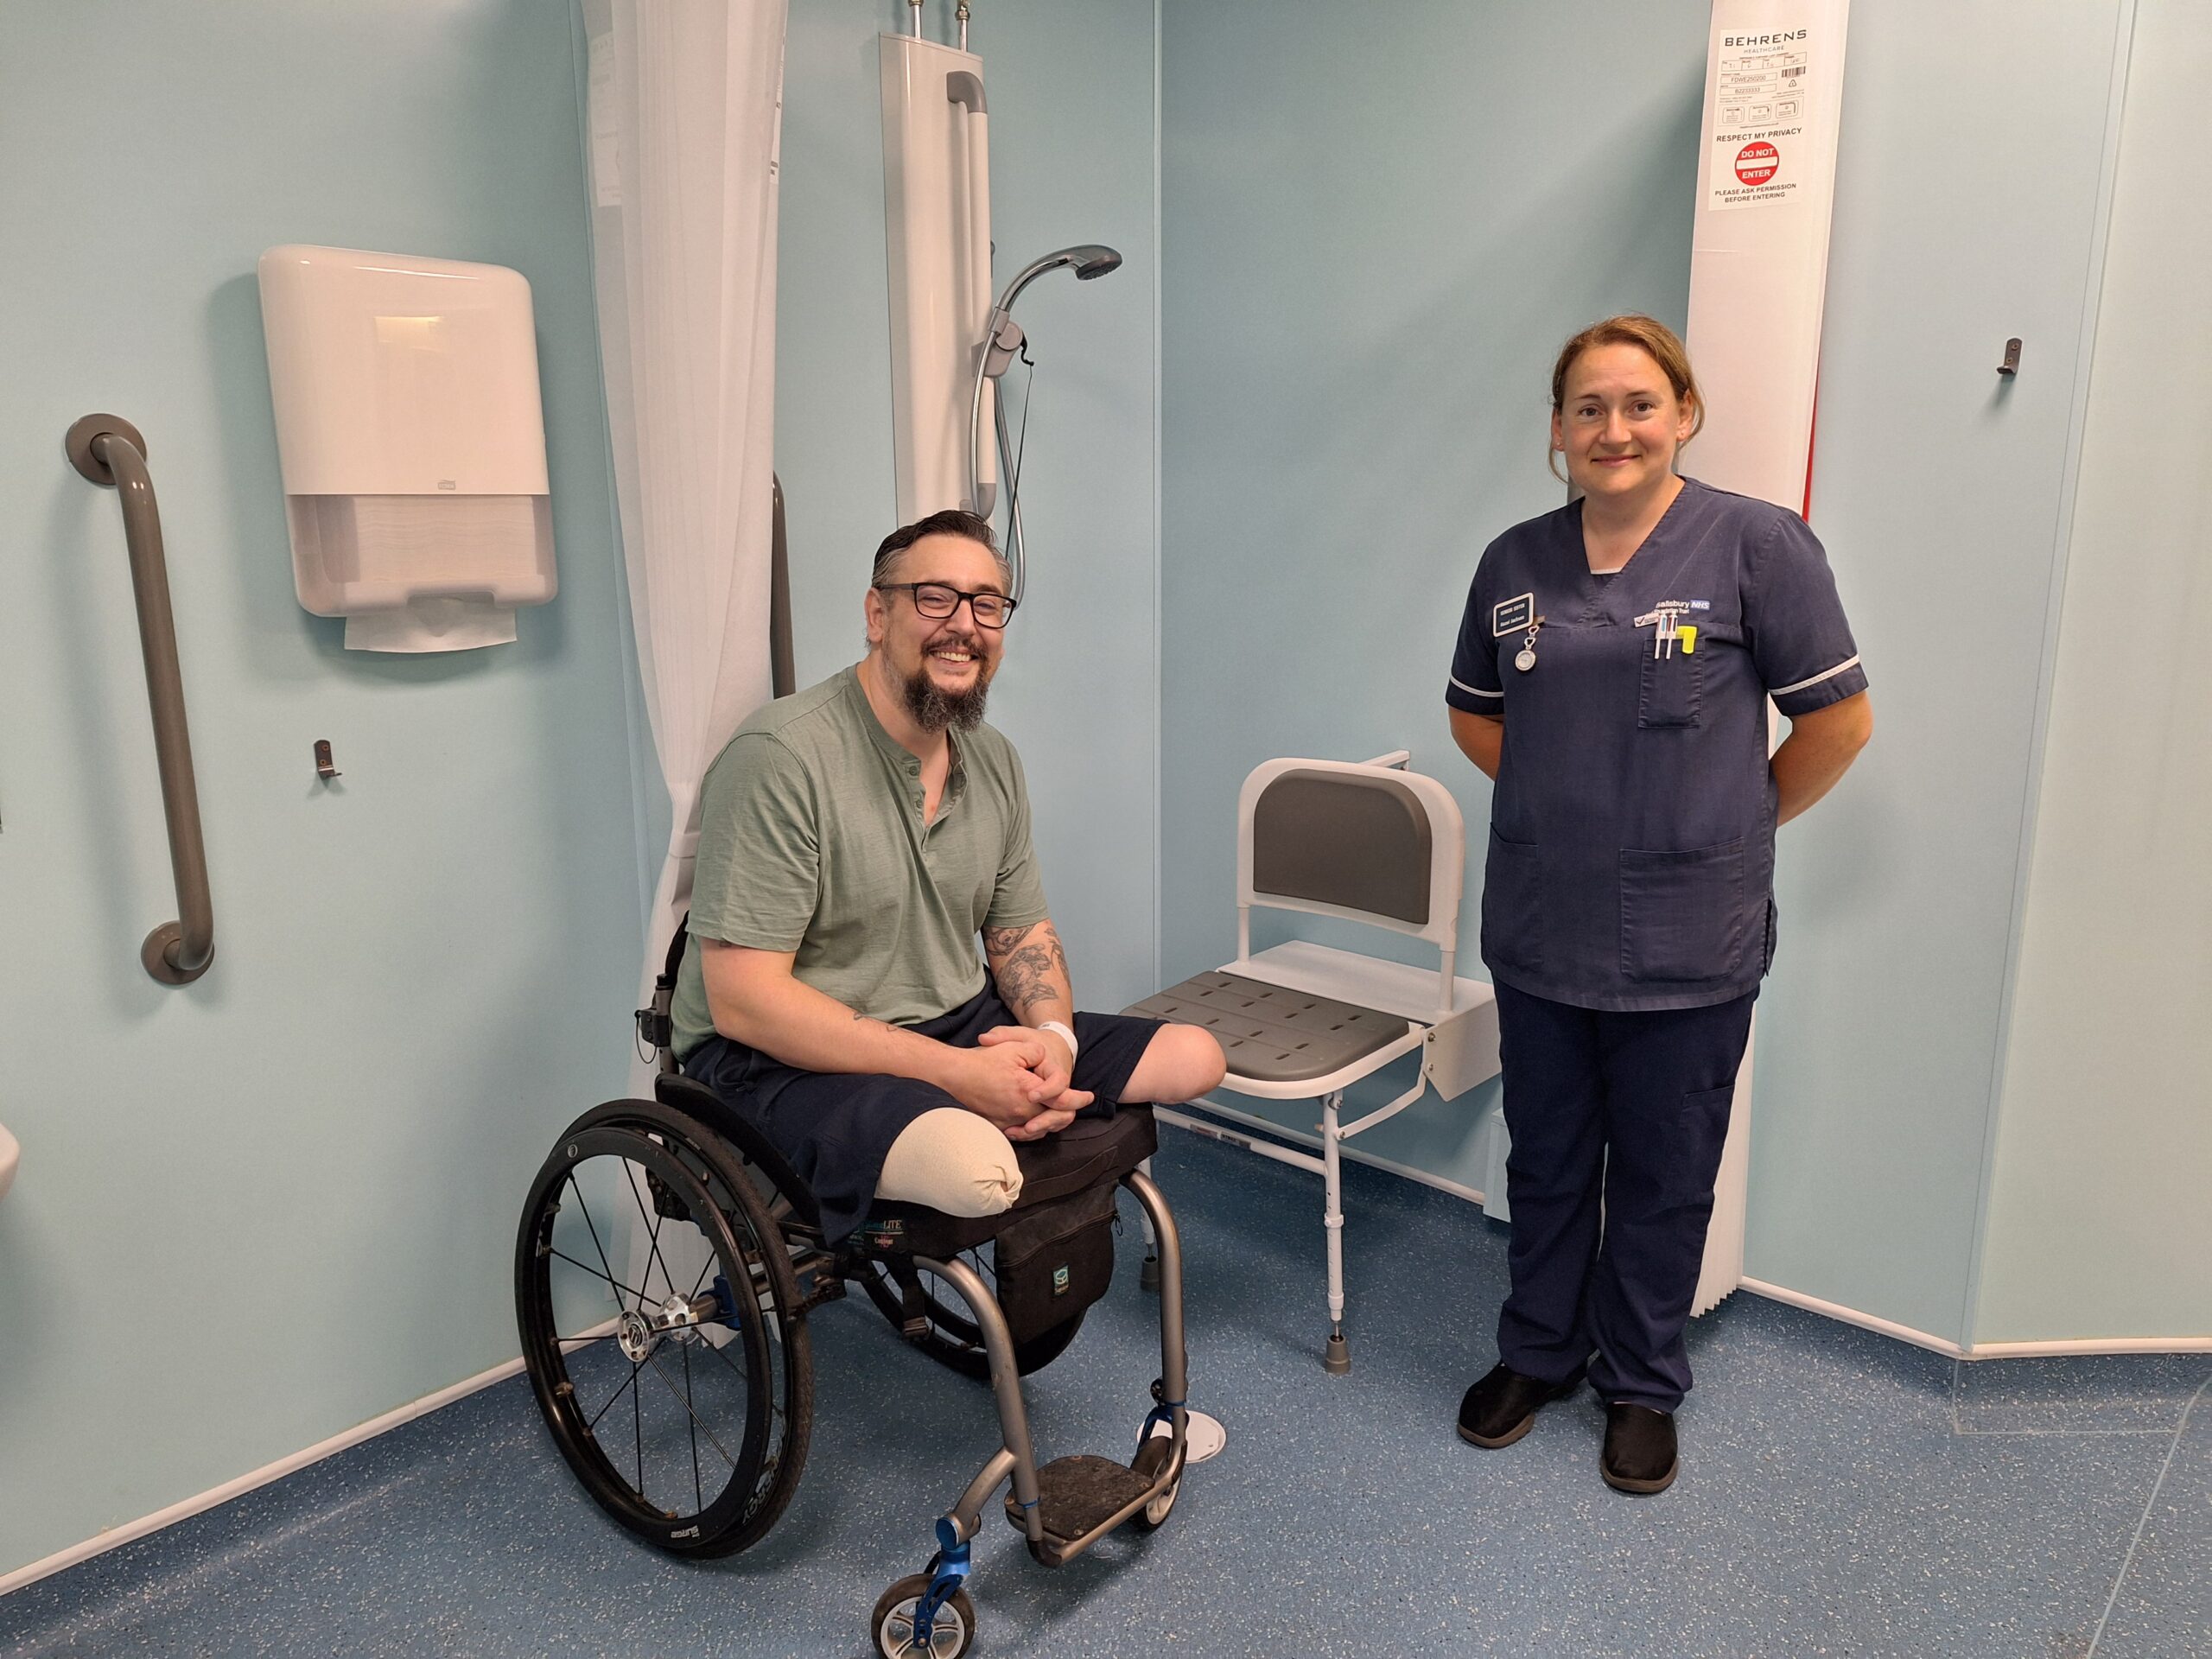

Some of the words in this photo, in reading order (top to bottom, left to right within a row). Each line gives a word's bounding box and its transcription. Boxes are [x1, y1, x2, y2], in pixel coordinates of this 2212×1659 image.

[1725, 29, 1807, 47] BEHRENS
[1744, 45, 1784, 54] HEALTHCARE
[1716, 133, 1752, 142] RESPECT
[1768, 127, 1802, 138] PRIVACY
[1756, 148, 1775, 157] NOT
[1742, 169, 1771, 179] ENTER
[1757, 183, 1796, 193] PERMISSION
[1752, 192, 1785, 200] ENTERING
